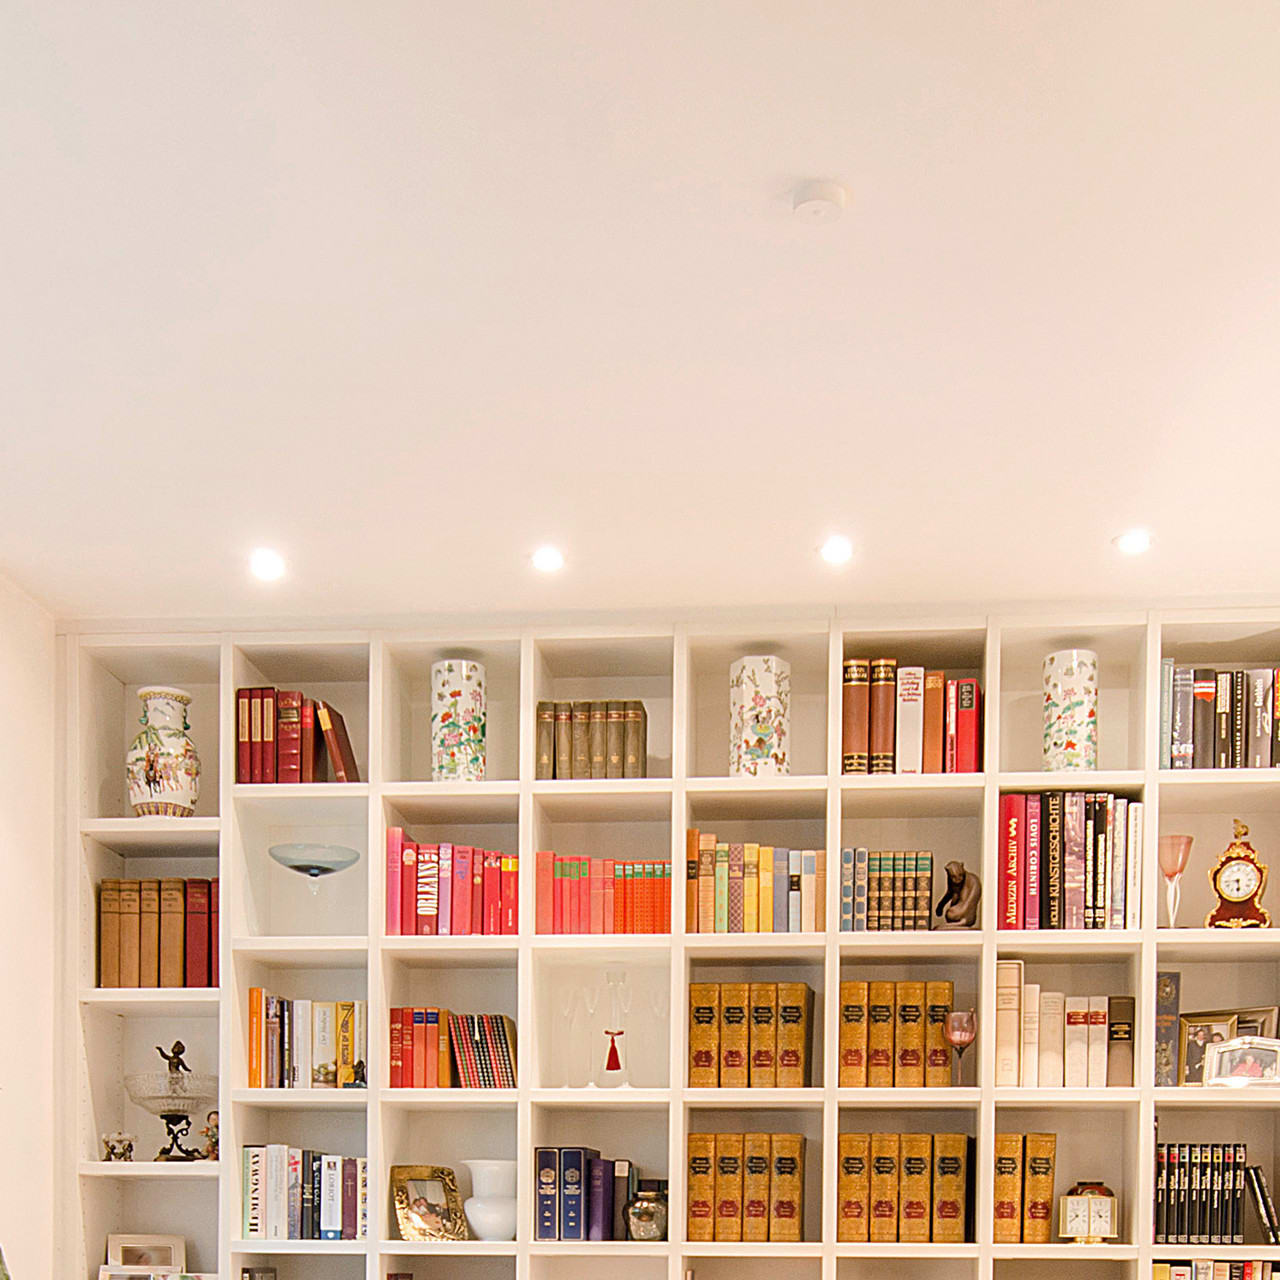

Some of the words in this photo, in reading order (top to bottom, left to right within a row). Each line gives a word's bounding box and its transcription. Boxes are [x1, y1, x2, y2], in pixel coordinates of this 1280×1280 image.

[1030, 818, 1038, 847] LOVIS
[1048, 796, 1060, 897] KUNSTGESCHICHTE
[1007, 839, 1017, 876] ARCHIV
[1029, 850, 1038, 896] CORINTH
[417, 862, 439, 916] ORLEANS
[1006, 880, 1017, 924] MEDIZIN
[1050, 899, 1058, 926] HOLLE
[248, 1153, 260, 1233] HEMINGWAY
[328, 1173, 336, 1202] LORIOT
